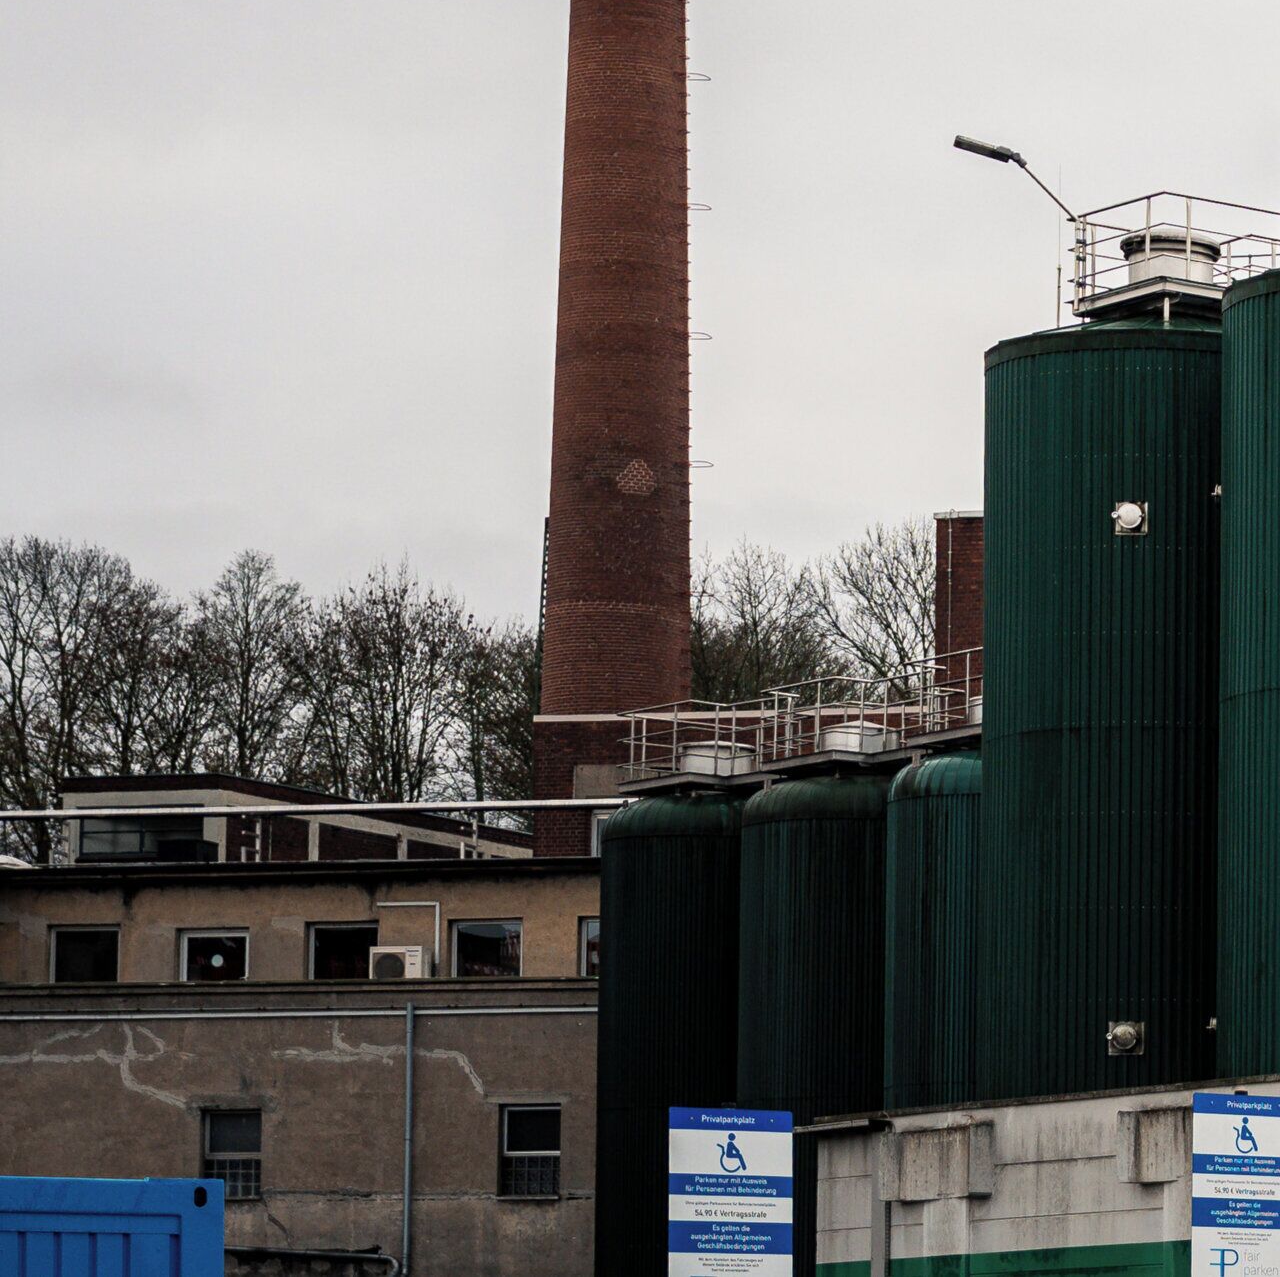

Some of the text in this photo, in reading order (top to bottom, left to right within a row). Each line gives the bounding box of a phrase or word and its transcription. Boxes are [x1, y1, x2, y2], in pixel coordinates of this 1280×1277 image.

[1227, 1101, 1272, 1110] Privatparkplatz
[702, 1114, 755, 1125] Privatparkplatz
[1254, 1157, 1275, 1165] Ausweis
[738, 1186, 777, 1195] Behinderung
[1236, 1188, 1275, 1196] Vertragsstrafe
[720, 1210, 767, 1219] Vertragsstrafe
[1216, 1217, 1273, 1226] Geschäftsbedingungen
[721, 1225, 740, 1233] gelten
[690, 1233, 771, 1242] ausgehängten Allgemeinen
[697, 1242, 765, 1251] Geschäftsbedingungen
[1244, 1249, 1262, 1263] fair
[1244, 1265, 1279, 1277] parken
